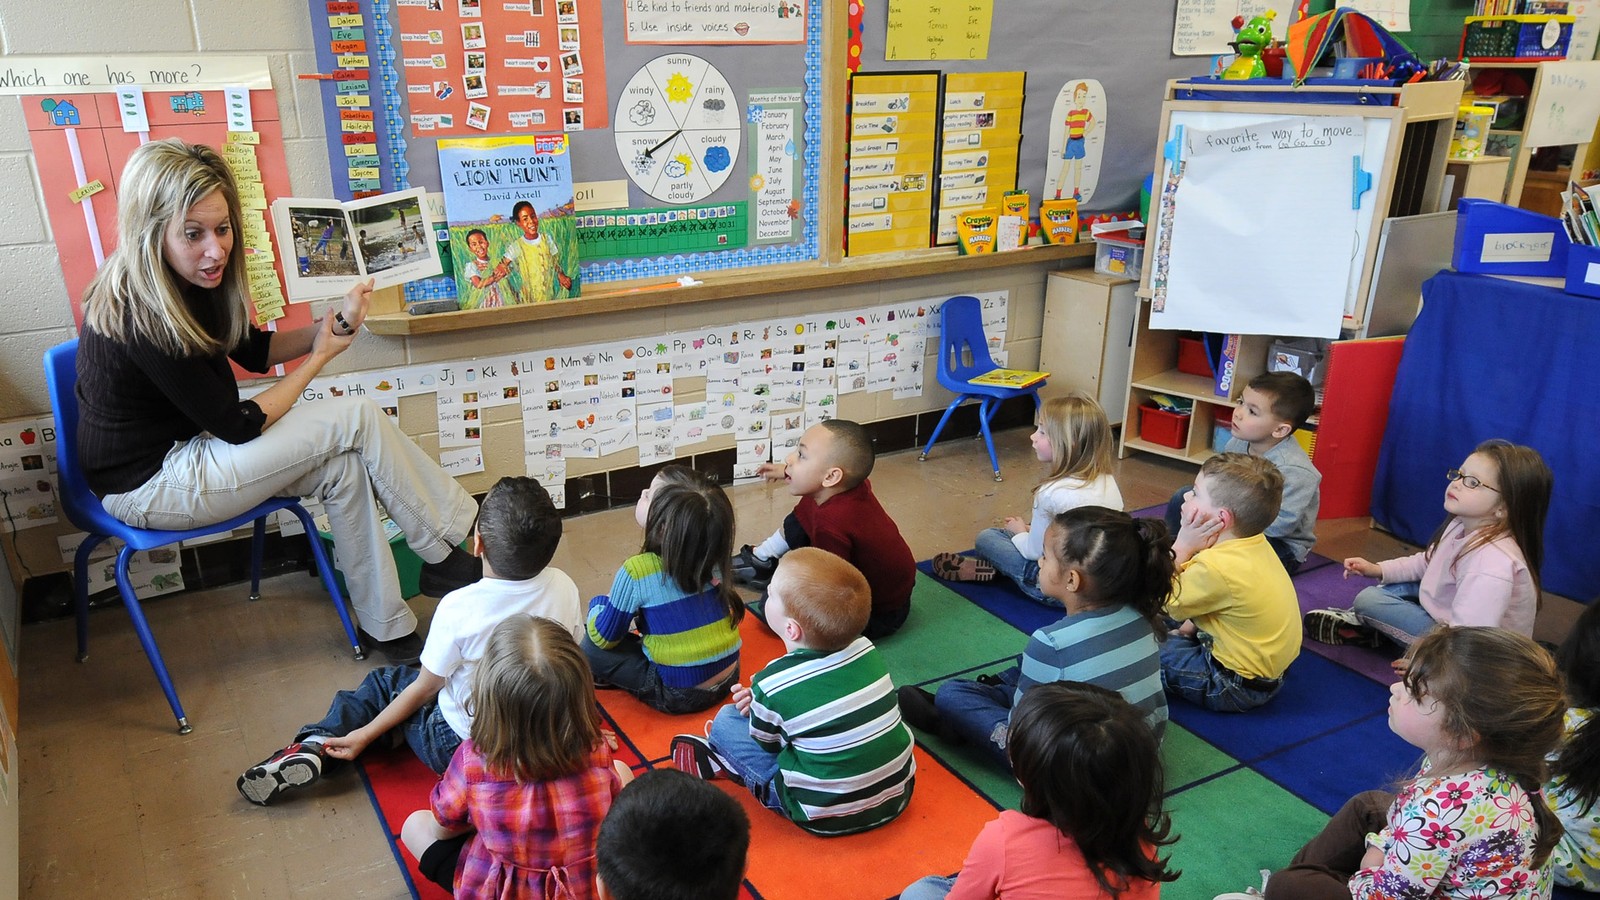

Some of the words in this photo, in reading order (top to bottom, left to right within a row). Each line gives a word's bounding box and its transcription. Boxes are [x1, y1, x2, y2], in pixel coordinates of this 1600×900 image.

[637, 1, 649, 12] Be
[651, 1, 668, 12] kind
[671, 1, 681, 12] to
[684, 1, 712, 13] friends
[714, 1, 730, 12] and
[968, 16, 978, 25] Eve
[641, 22, 659, 32] Use
[667, 21, 694, 32] inside
[337, 31, 352, 39] Eve
[335, 44, 358, 52] Megan
[891, 46, 896, 59] A
[930, 48, 937, 59] B
[969, 48, 975, 58] C
[667, 56, 692, 66] sunny
[63, 72, 91, 86] one
[105, 64, 136, 85] has
[149, 63, 202, 85] more?
[629, 86, 655, 96] windy
[705, 86, 725, 95] rainy
[763, 111, 788, 119] January
[761, 122, 790, 131] February
[701, 135, 727, 144] cloudy
[1204, 128, 1259, 147] favorite
[1272, 128, 1292, 140] way
[1300, 122, 1313, 138] to
[768, 145, 783, 153] April
[1256, 141, 1273, 149] from
[460, 159, 491, 168] WE'RE
[494, 157, 526, 167] GOING
[530, 156, 544, 165] ON
[548, 156, 555, 164] A
[454, 168, 501, 187] LION
[509, 166, 564, 184] HUNT
[768, 177, 782, 186] July
[670, 181, 693, 191] partly
[484, 192, 511, 201] David
[514, 190, 541, 200] Axtell
[668, 191, 695, 200] cloudy
[765, 188, 786, 197] August
[758, 198, 791, 206] September
[761, 208, 787, 216] October
[1048, 208, 1071, 216] Crayola
[718, 221, 726, 229] 30
[727, 220, 735, 228] 31
[759, 219, 790, 227] November
[965, 216, 991, 224] Crayola
[760, 230, 790, 238] December
[257, 291, 272, 299] Jack
[984, 299, 993, 309] Zz
[898, 306, 916, 320] Ww
[839, 318, 851, 329] Uu
[870, 314, 880, 324] Vv
[776, 326, 787, 336] Ss
[806, 322, 817, 333] Tt
[743, 329, 755, 341] Rr
[707, 334, 723, 347] Qq
[673, 340, 686, 353] Pp
[636, 346, 652, 358] Oo
[561, 356, 580, 368] Mm
[599, 352, 613, 363] Nn
[522, 360, 533, 373] Ll
[440, 368, 455, 386] Jj
[482, 366, 497, 378] Kk
[396, 378, 405, 390] Ii
[560, 380, 580, 389] Megan
[348, 384, 366, 396] Hh
[438, 397, 453, 405] Jack
[441, 431, 455, 439] Joey
